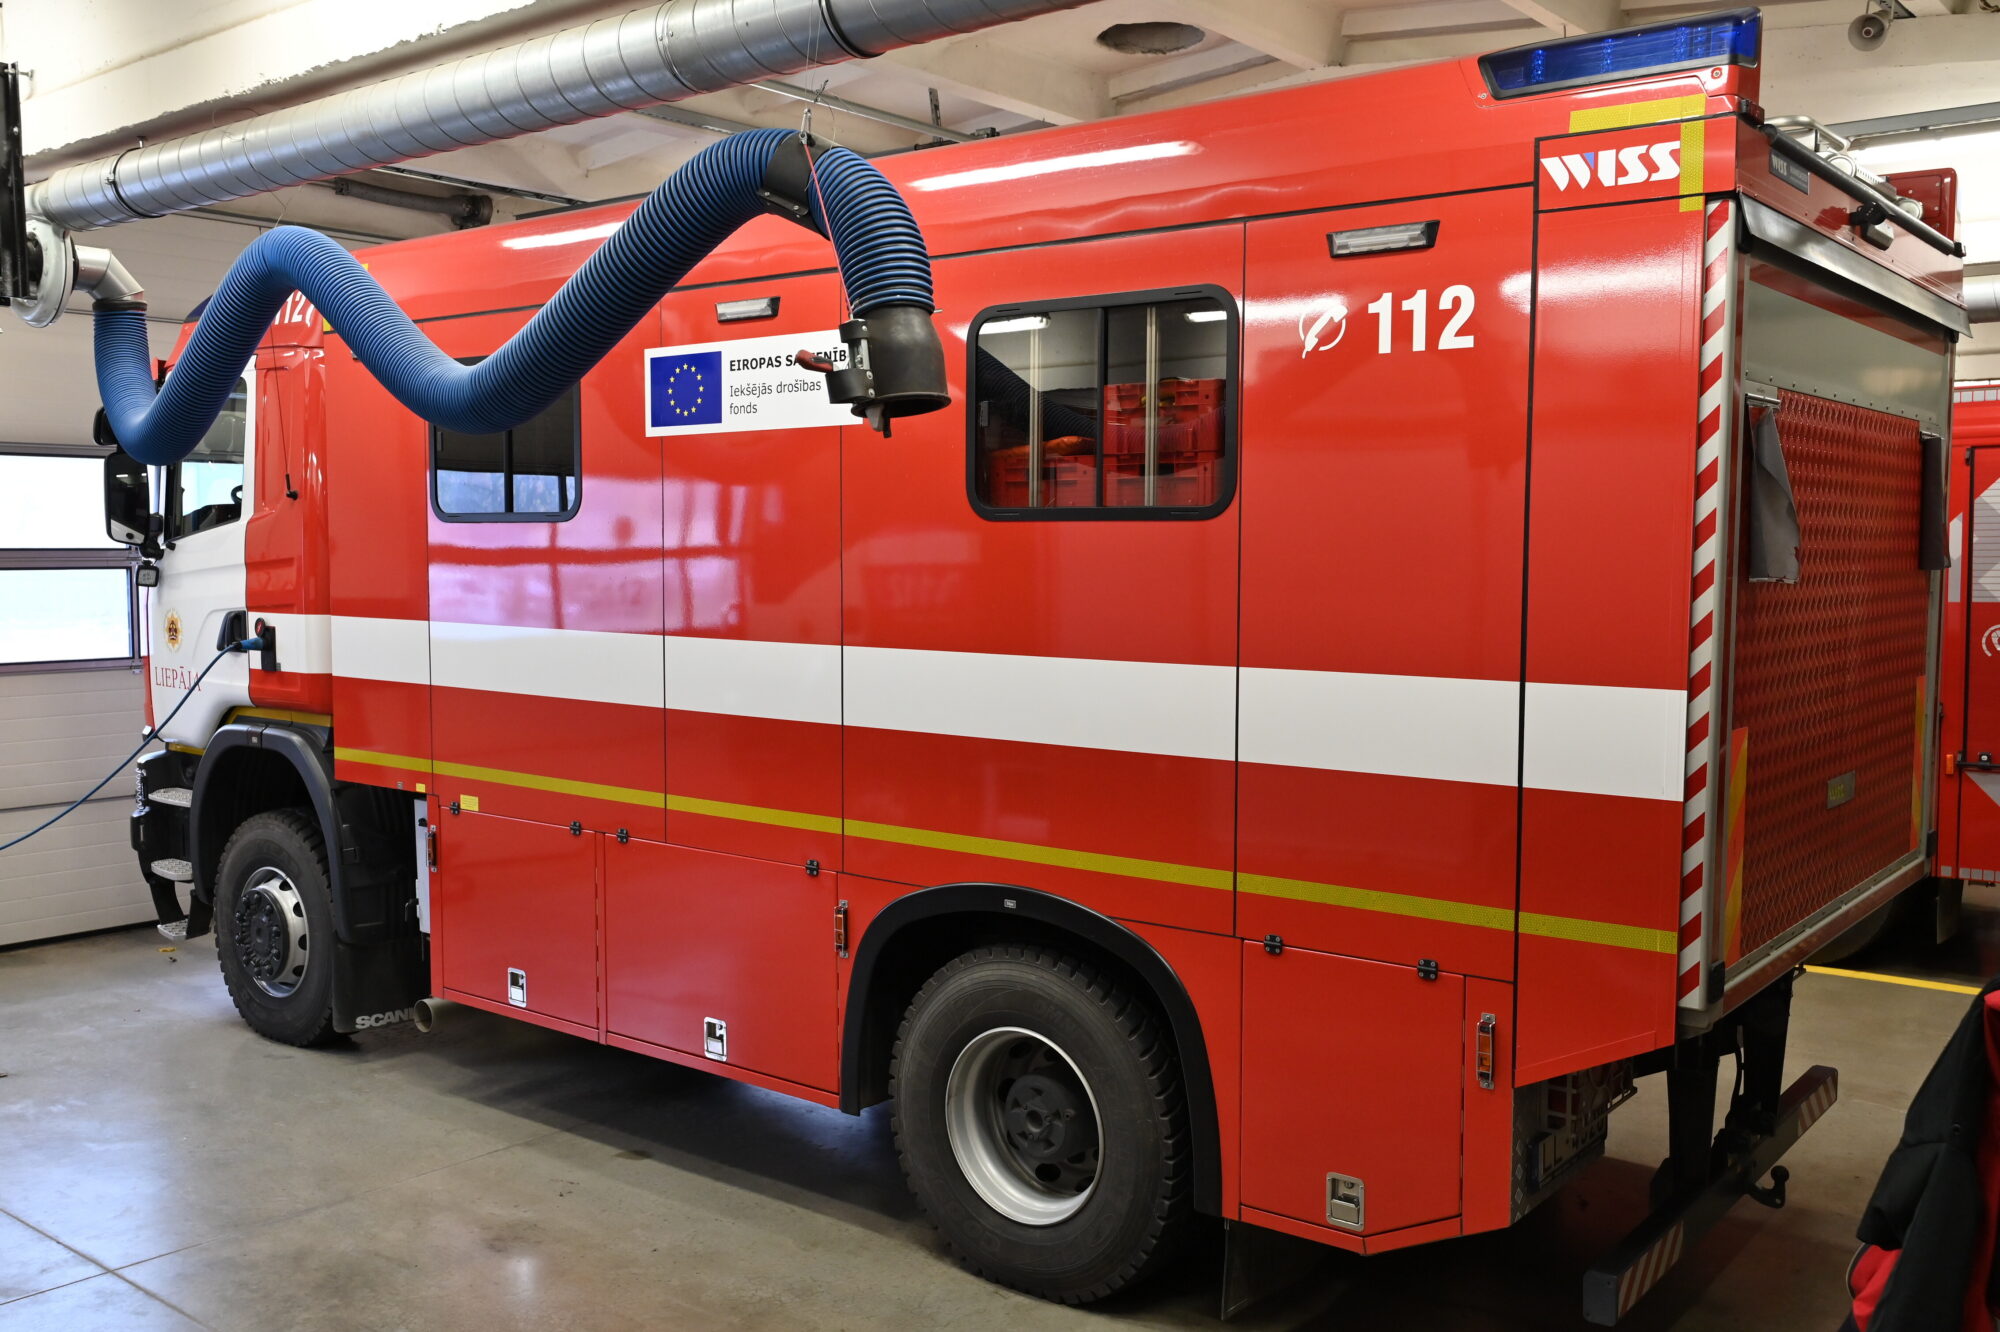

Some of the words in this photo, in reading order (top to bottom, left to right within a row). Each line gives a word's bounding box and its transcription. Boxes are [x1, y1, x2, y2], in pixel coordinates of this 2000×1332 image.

[1540, 140, 1681, 192] WISS
[1367, 284, 1476, 354] 112
[729, 355, 782, 372] EIROPAS
[729, 379, 773, 399] Iekšējās
[776, 378, 822, 395] drošības
[729, 402, 758, 416] fonds
[155, 666, 202, 692] LIEPĀJA
[355, 1007, 415, 1030] SCANI
